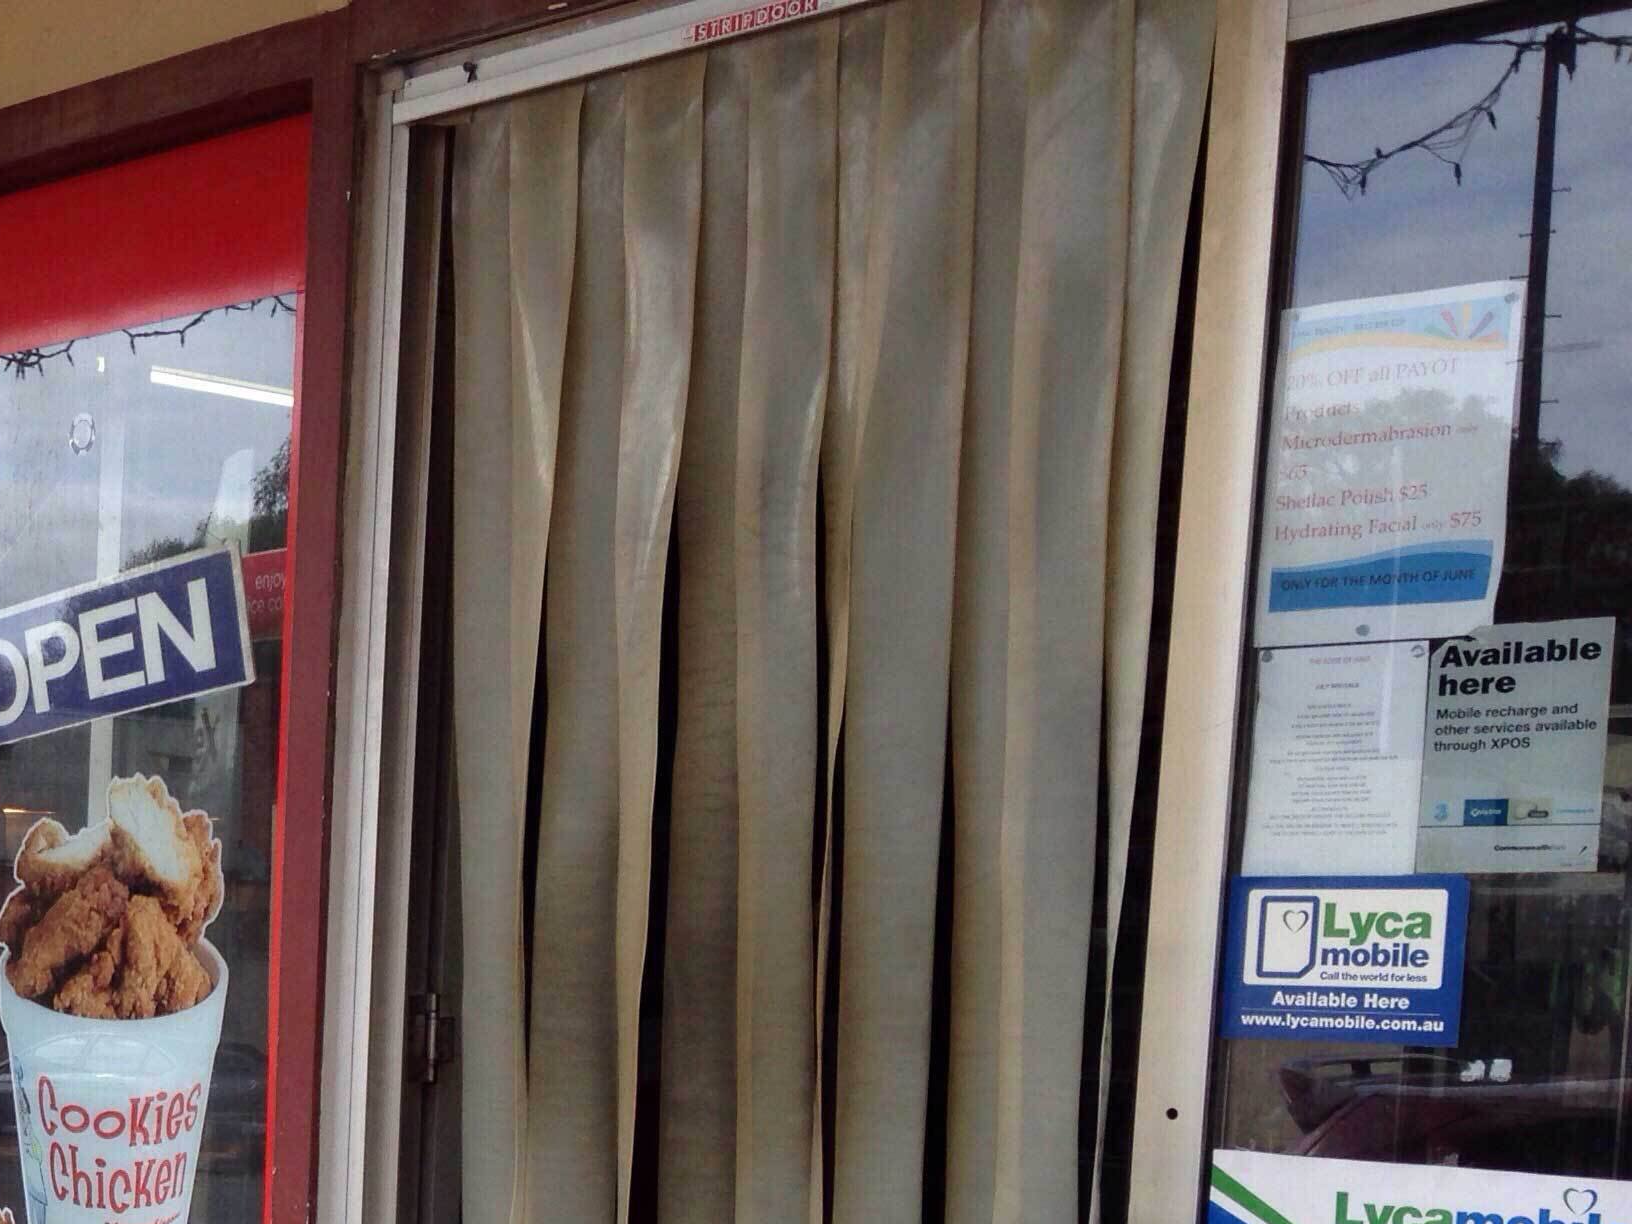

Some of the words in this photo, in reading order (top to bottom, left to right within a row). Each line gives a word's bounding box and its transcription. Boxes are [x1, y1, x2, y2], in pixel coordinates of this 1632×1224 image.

[697, 0, 816, 40] STRIPDOOR
[1327, 367, 1362, 386] OFF
[1368, 364, 1392, 382] all
[1396, 358, 1458, 380] PAYOT
[1284, 402, 1360, 421] Products
[1282, 423, 1452, 450] Microdermabrasion
[1275, 492, 1336, 512] Shellac
[1340, 488, 1394, 507] Polish
[1399, 483, 1428, 500] $25
[1274, 521, 1363, 544] Hydrating
[1368, 515, 1417, 535] Facial
[1449, 511, 1482, 529] $75
[1281, 578, 1311, 592] ONLY
[1316, 576, 1338, 589] FOR
[1342, 575, 1366, 587] THE
[1370, 571, 1420, 586] MONTH
[1422, 570, 1439, 582] OF
[1442, 568, 1476, 582] JUNE
[1440, 638, 1602, 668] Available
[1439, 674, 1516, 697] here
[1436, 707, 1481, 721] Mobile
[1485, 705, 1548, 720] recharge
[1551, 703, 1578, 715] and
[1434, 724, 1470, 736] other
[1473, 722, 1530, 734] services
[1535, 719, 1597, 732] available
[1434, 738, 1486, 753] through
[1491, 737, 1530, 749] XPOS
[1323, 903, 1432, 946] Lyca
[1321, 942, 1430, 968] mobile
[1319, 971, 1340, 982] Call
[1341, 972, 1359, 982] the
[1359, 972, 1389, 983] world
[1390, 972, 1406, 983] for
[1406, 973, 1428, 983] less
[1272, 991, 1358, 1009] Available
[1364, 993, 1410, 1010] Here
[1241, 1013, 1445, 1033] www.lycamobile.com.au
